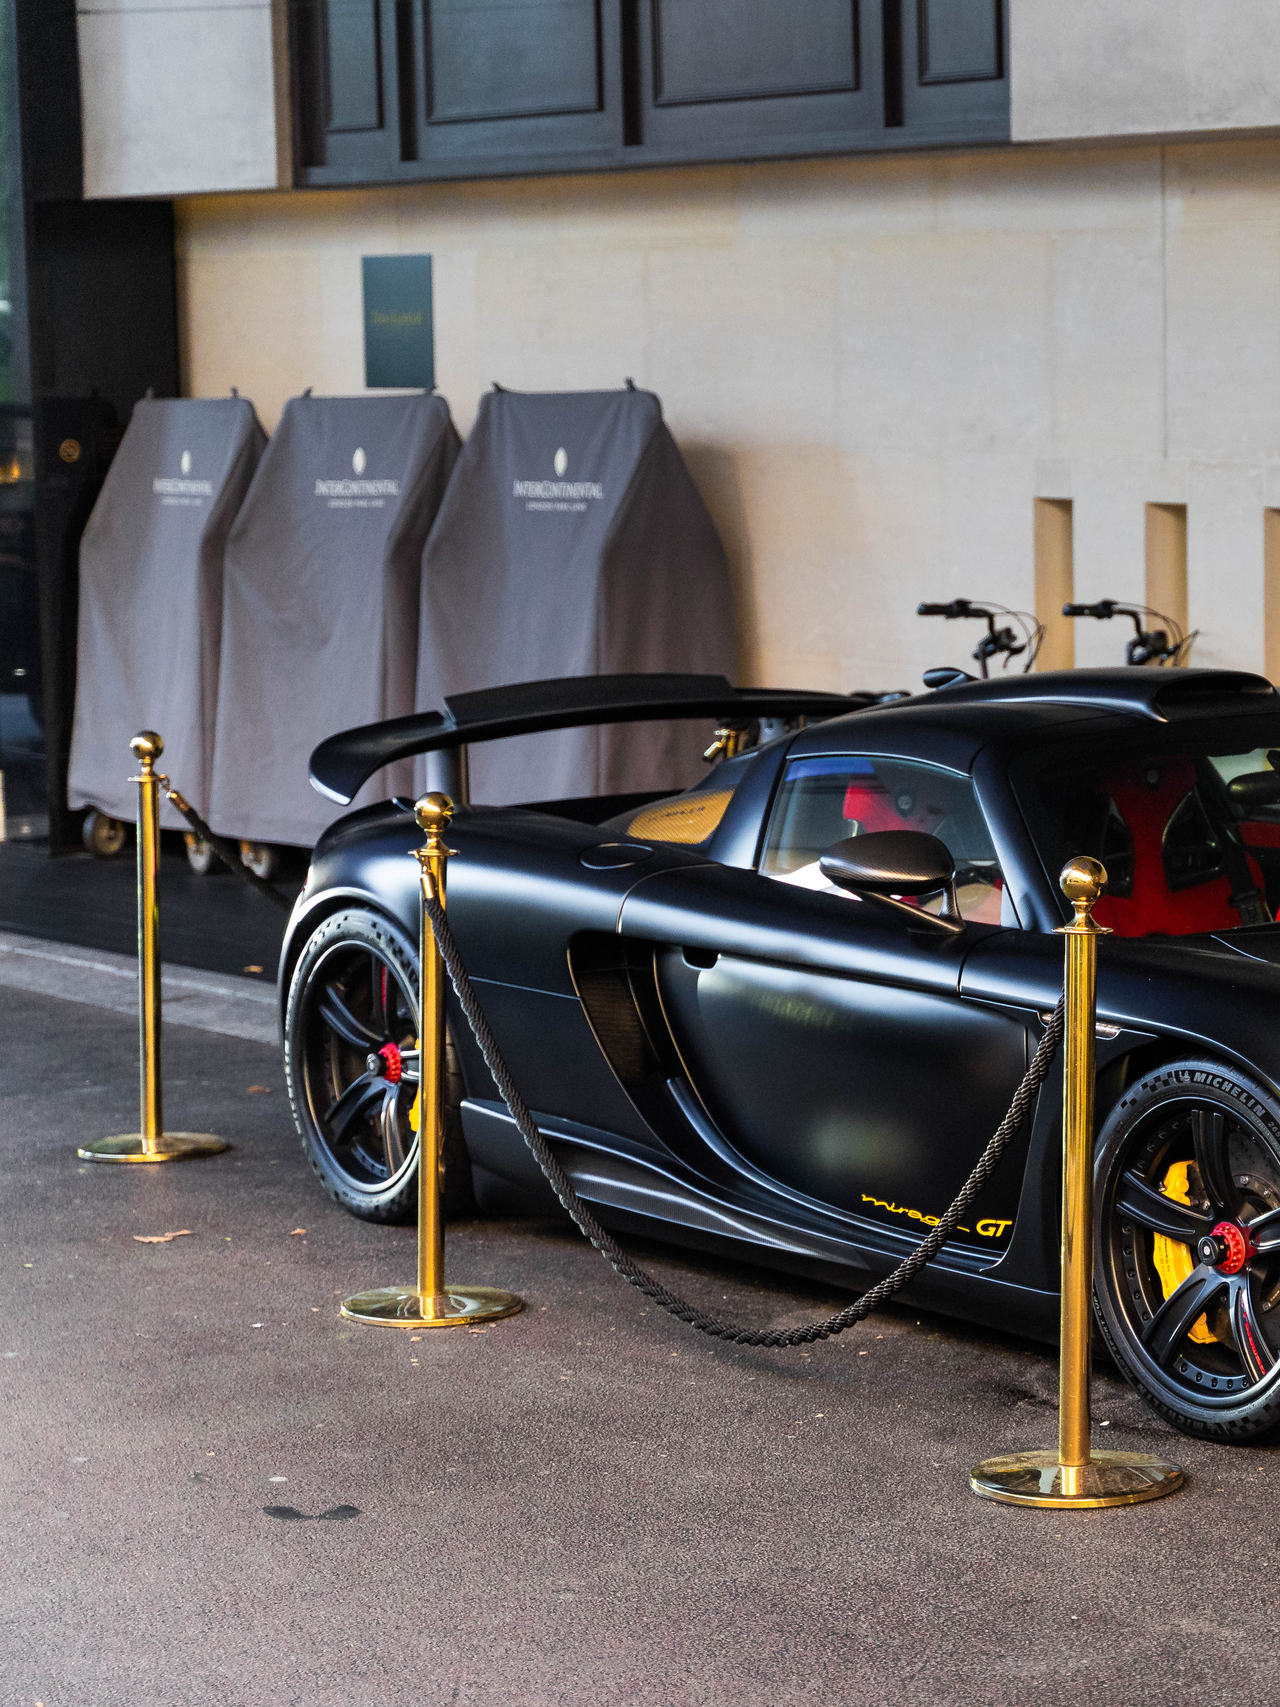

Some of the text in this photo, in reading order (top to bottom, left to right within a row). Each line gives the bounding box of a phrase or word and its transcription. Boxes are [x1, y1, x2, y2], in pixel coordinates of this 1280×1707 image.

[1193, 1072, 1266, 1117] MICHELIN
[861, 1194, 1013, 1238] mirag GT
